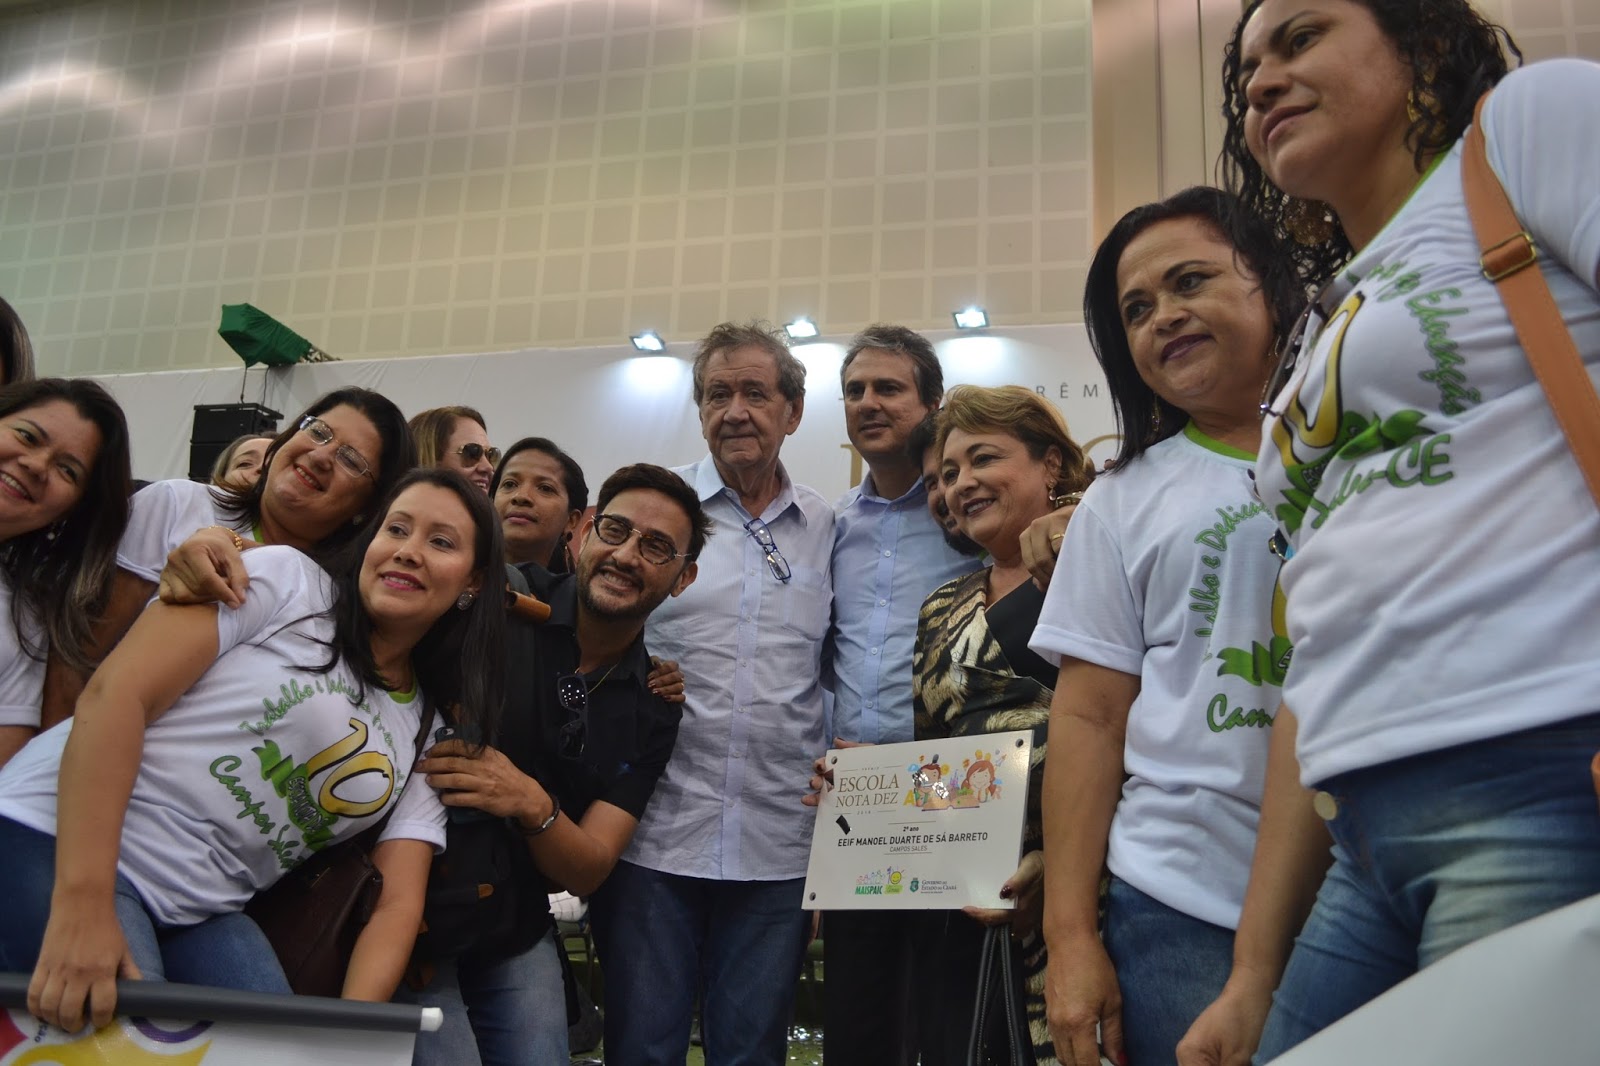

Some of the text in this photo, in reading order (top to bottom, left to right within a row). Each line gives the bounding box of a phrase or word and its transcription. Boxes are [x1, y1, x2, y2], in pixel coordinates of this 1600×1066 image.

[1036, 382, 1098, 399] RÊM
[238, 677, 316, 737] Trabalho
[1206, 693, 1274, 733] Cam
[838, 773, 900, 793] ESCOLA
[209, 755, 276, 834] Campos
[835, 792, 899, 808] NOTA DEZ
[837, 831, 988, 847] EEIF MANOEL DUARTE DE SÁ BARRETO
[854, 885, 883, 895] MAISPAIC
